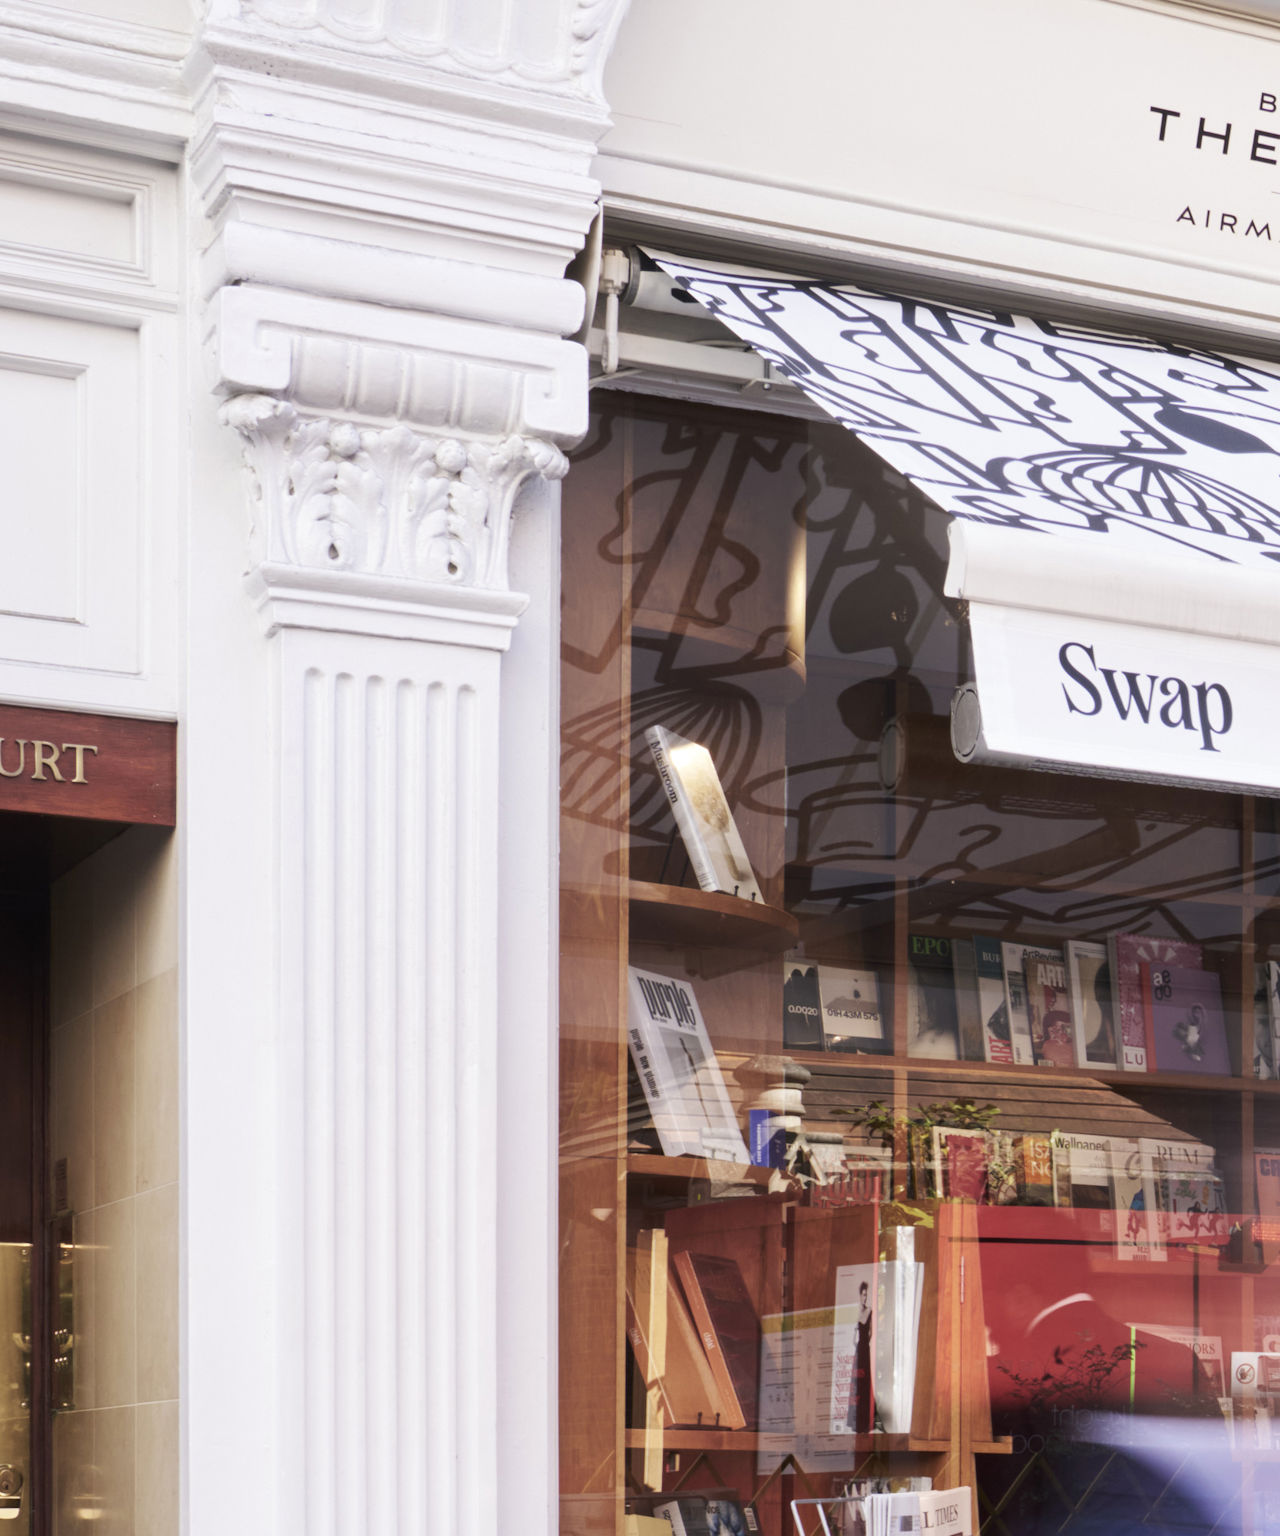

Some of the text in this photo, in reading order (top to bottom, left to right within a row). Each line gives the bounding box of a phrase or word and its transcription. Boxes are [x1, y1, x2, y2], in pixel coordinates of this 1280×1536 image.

[1058, 642, 1233, 752] Swap
[651, 741, 678, 804] Mushroom
[637, 975, 698, 1028] purple
[935, 1504, 959, 1527] TIMES
